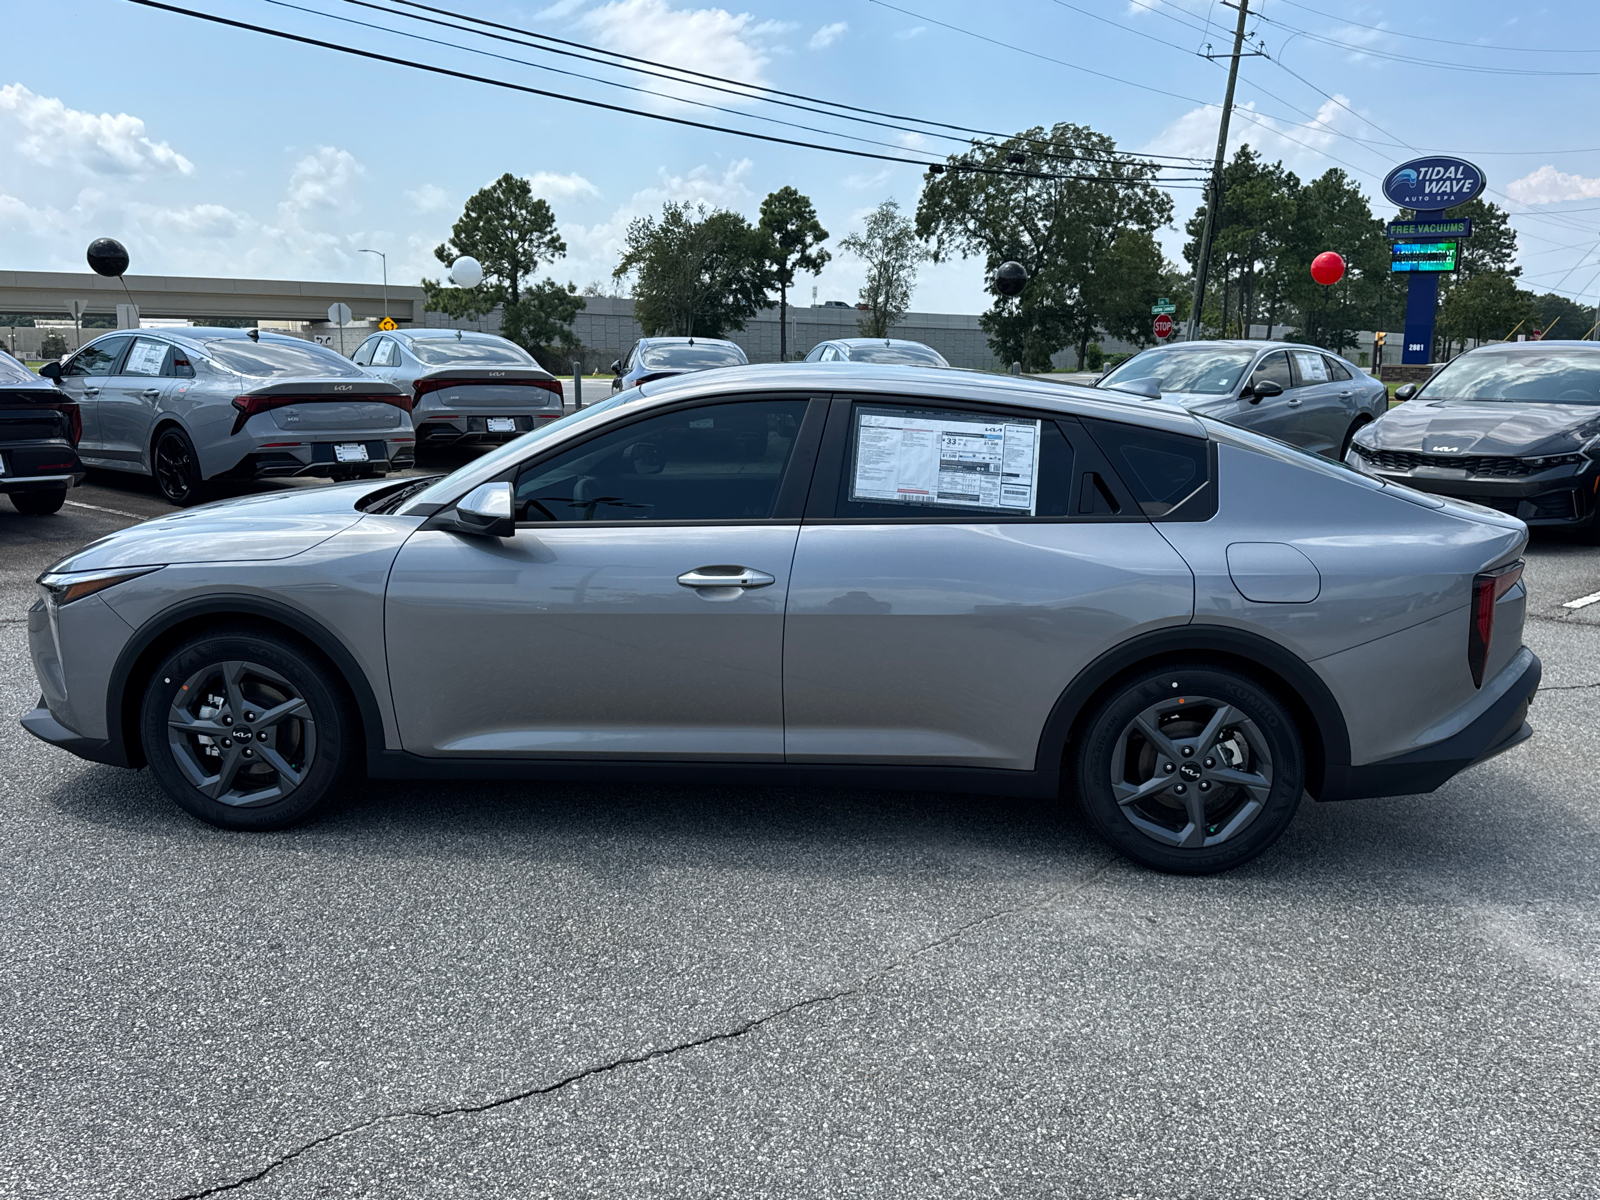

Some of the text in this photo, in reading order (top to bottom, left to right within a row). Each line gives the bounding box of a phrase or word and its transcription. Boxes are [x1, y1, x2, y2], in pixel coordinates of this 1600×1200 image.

[1418, 166, 1464, 180] TIDAL
[1424, 179, 1474, 194] WAVE
[1390, 223, 1464, 234] FREE VACUUMS
[1155, 322, 1171, 331] STOP
[1408, 343, 1424, 351] 2881
[946, 437, 957, 445] 33
[1225, 682, 1279, 728] KUMHO
[1181, 766, 1201, 779] KIA
